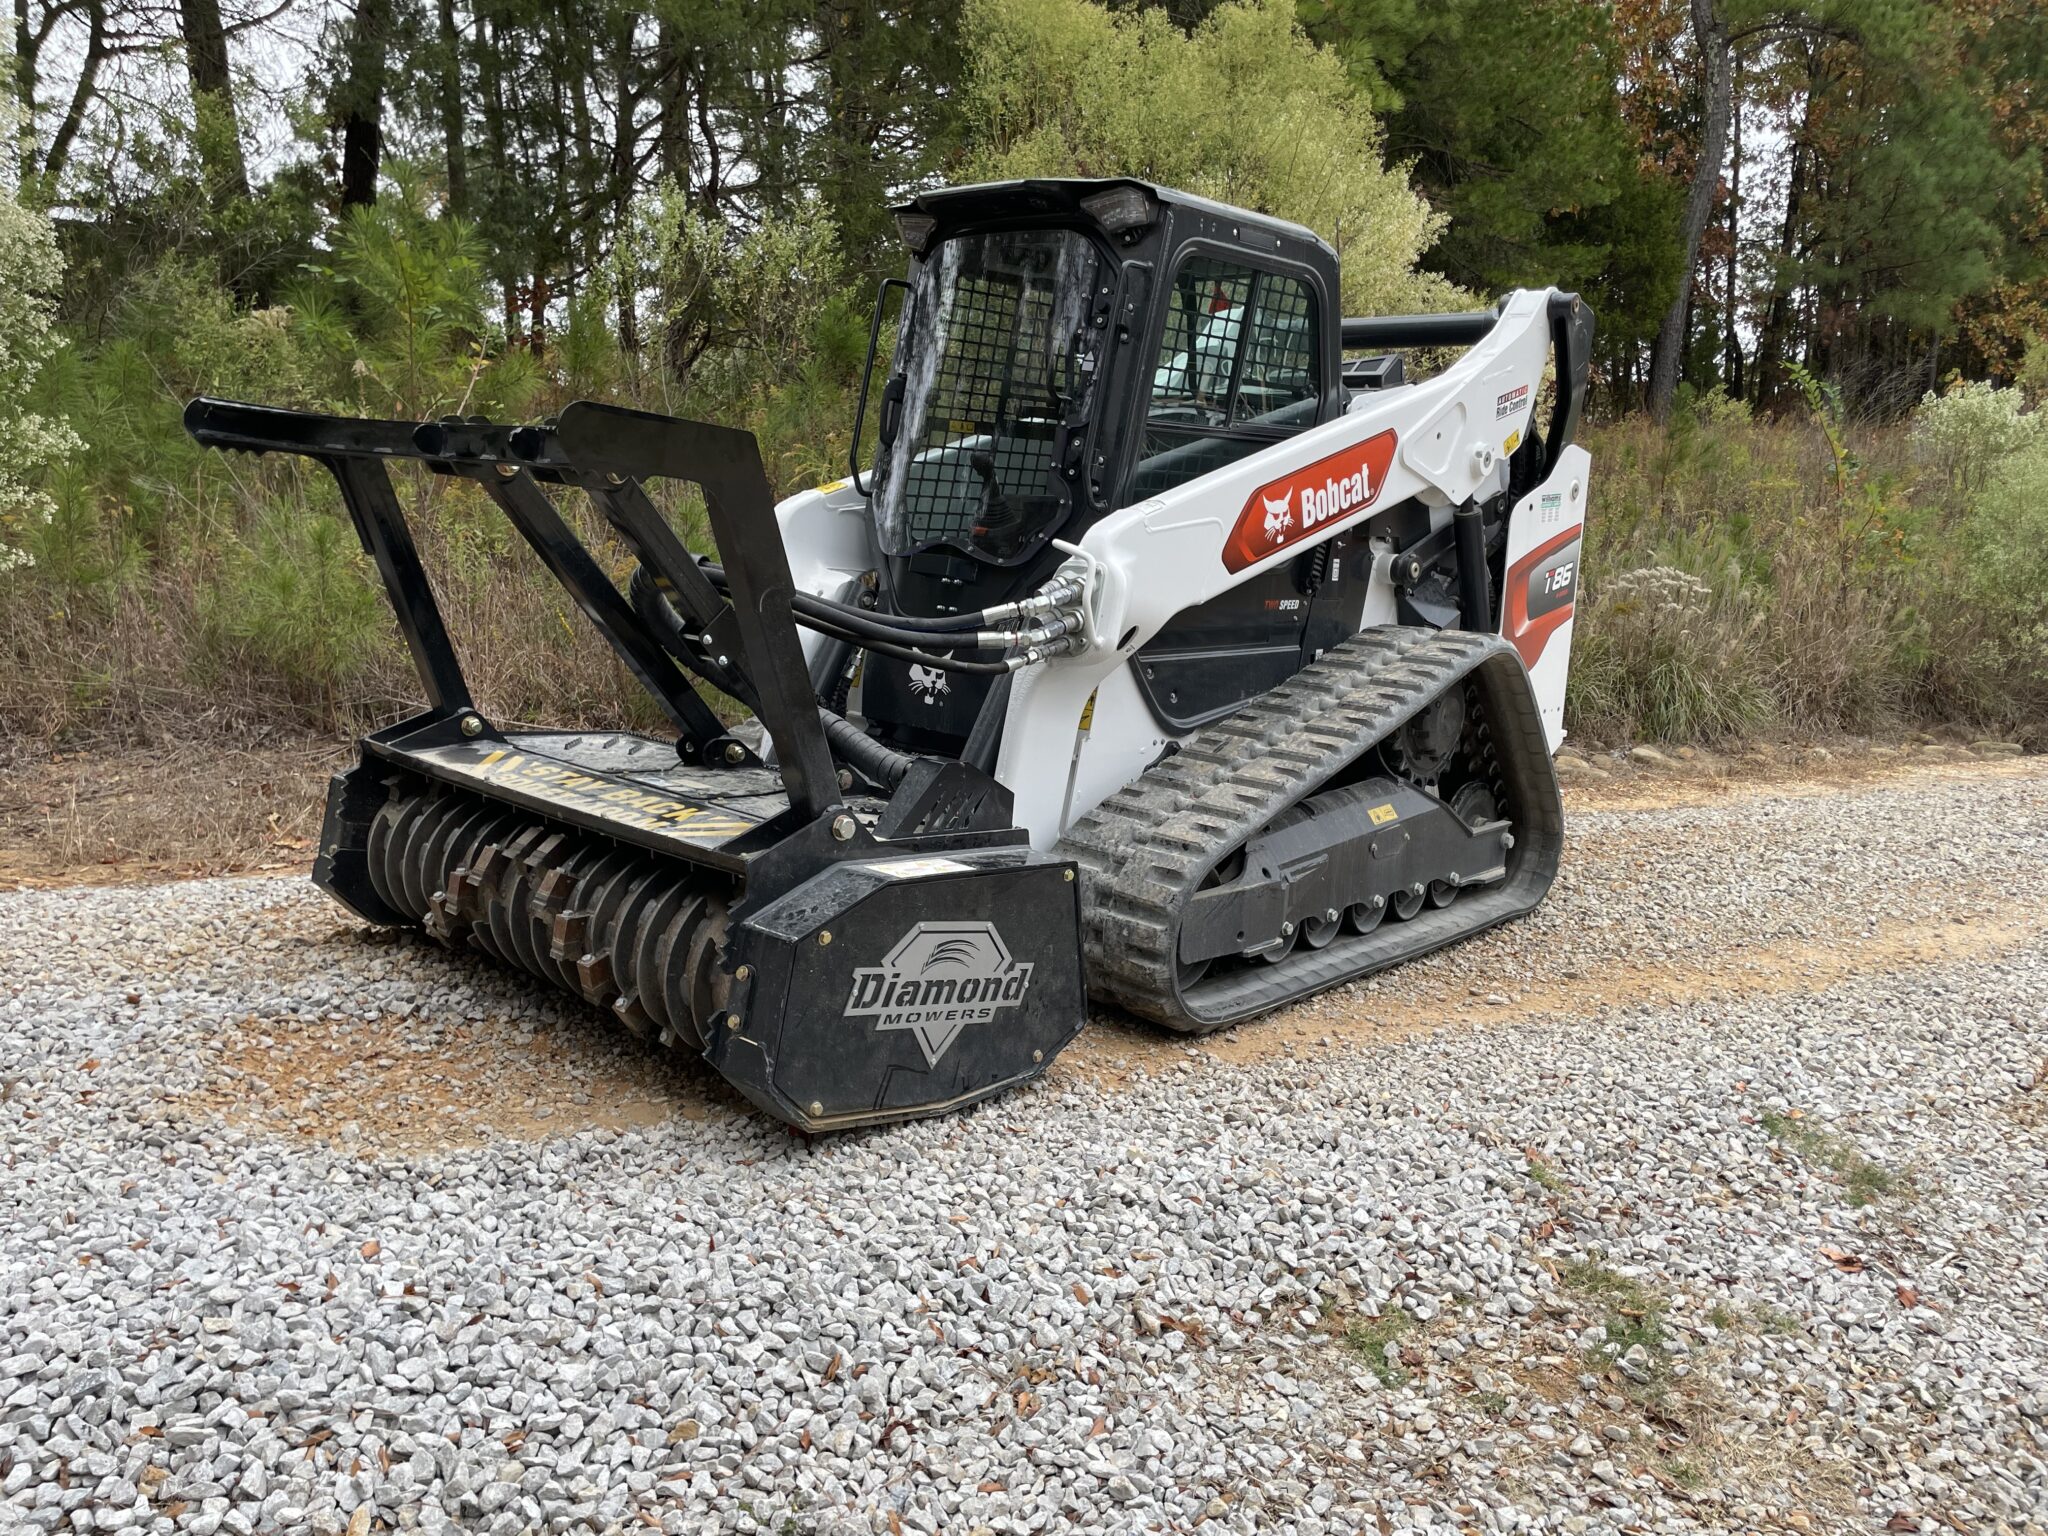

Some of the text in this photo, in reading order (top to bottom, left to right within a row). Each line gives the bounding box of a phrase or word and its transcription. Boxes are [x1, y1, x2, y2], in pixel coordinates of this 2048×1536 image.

[1496, 395, 1528, 418] Ride Control
[1301, 463, 1370, 529] Bobcat
[1545, 562, 1573, 594] T86
[1278, 599, 1299, 610] SPEED
[521, 766, 711, 824] STAY BACK
[851, 968, 1029, 1009] Diamond
[883, 1008, 992, 1025] MOWERS
